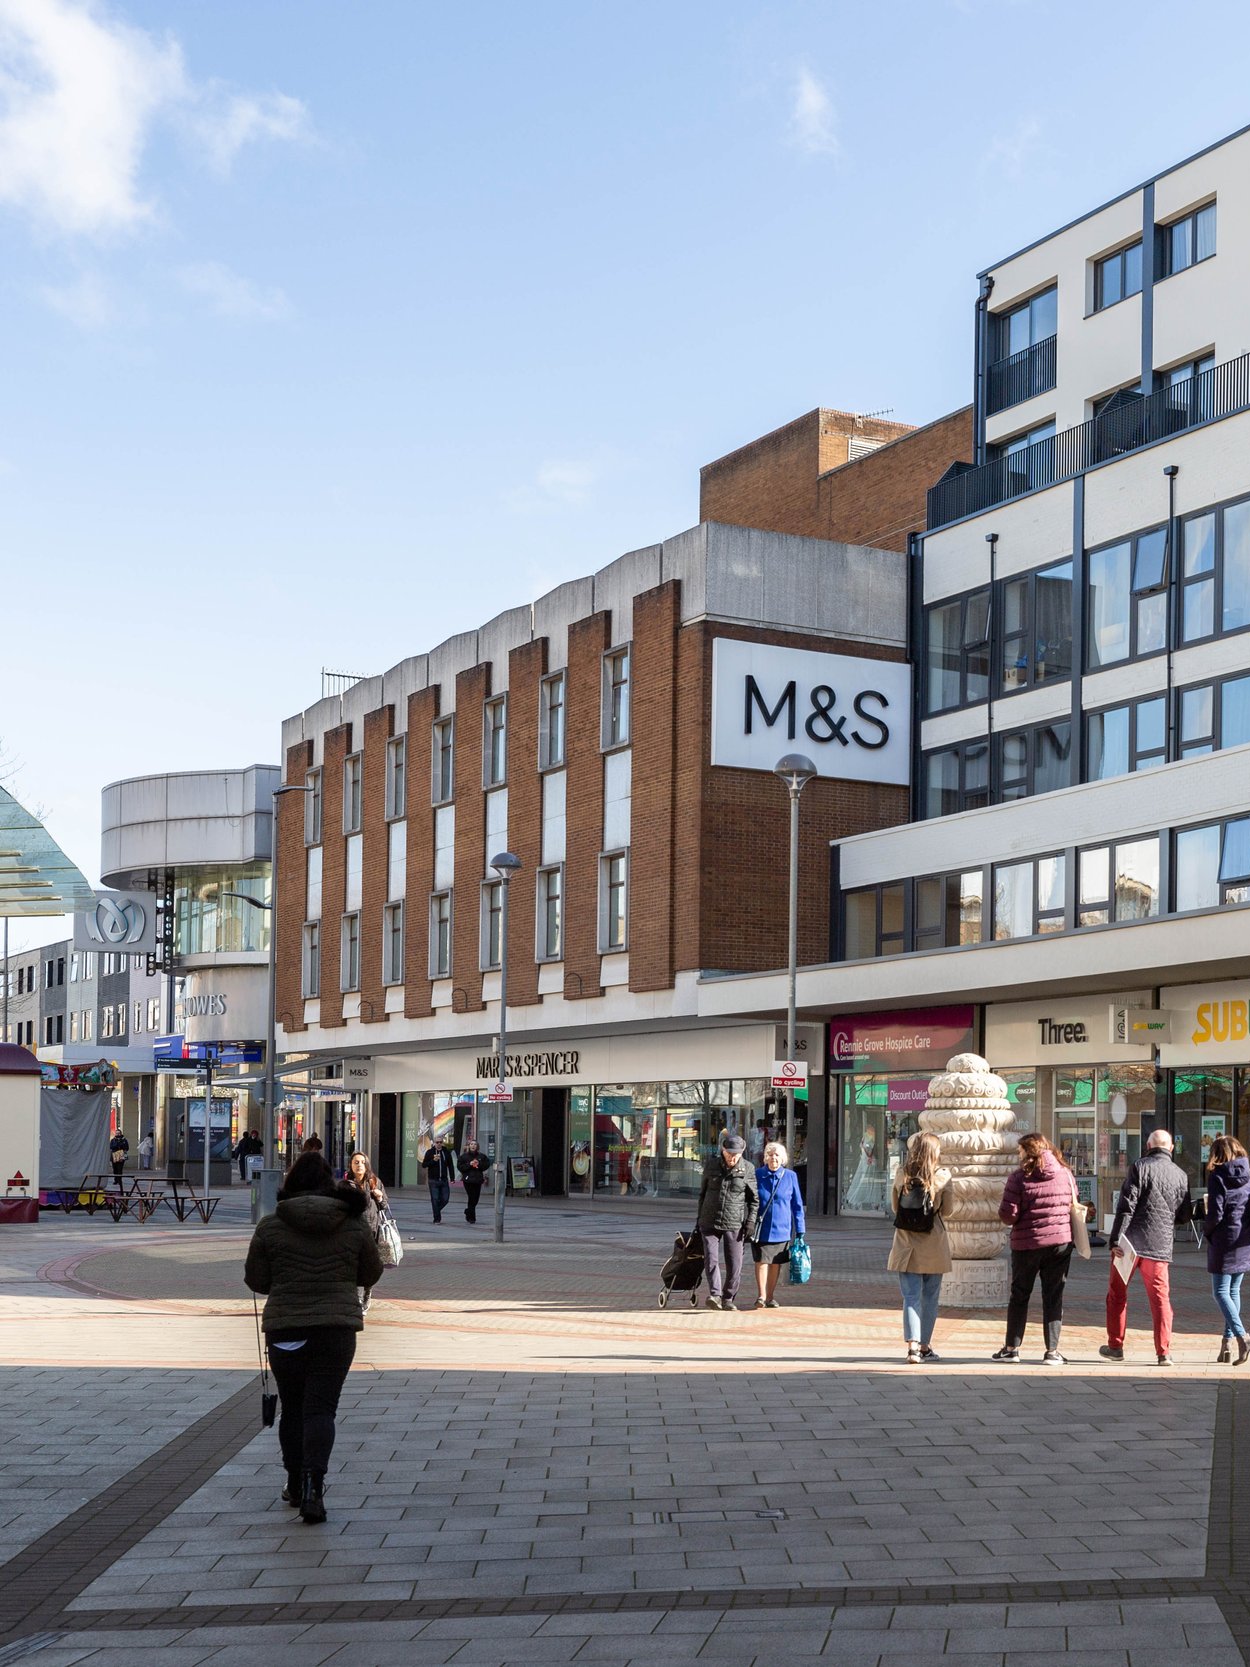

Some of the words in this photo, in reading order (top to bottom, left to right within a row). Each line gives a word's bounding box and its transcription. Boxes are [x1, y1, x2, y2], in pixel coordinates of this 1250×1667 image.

[744, 674, 890, 749] M&S
[1133, 1023, 1165, 1032] SUBWAY
[840, 1039, 863, 1053] Rennie
[863, 1038, 884, 1052] Grove
[885, 1036, 913, 1053] Hospice
[914, 1034, 931, 1049] Care
[476, 1055, 514, 1079] MARS
[523, 1051, 580, 1077] SPENCER
[349, 1069, 369, 1077] M&S
[784, 1079, 804, 1087] cycling
[890, 1090, 911, 1101] Discount
[912, 1089, 928, 1100] Outlet
